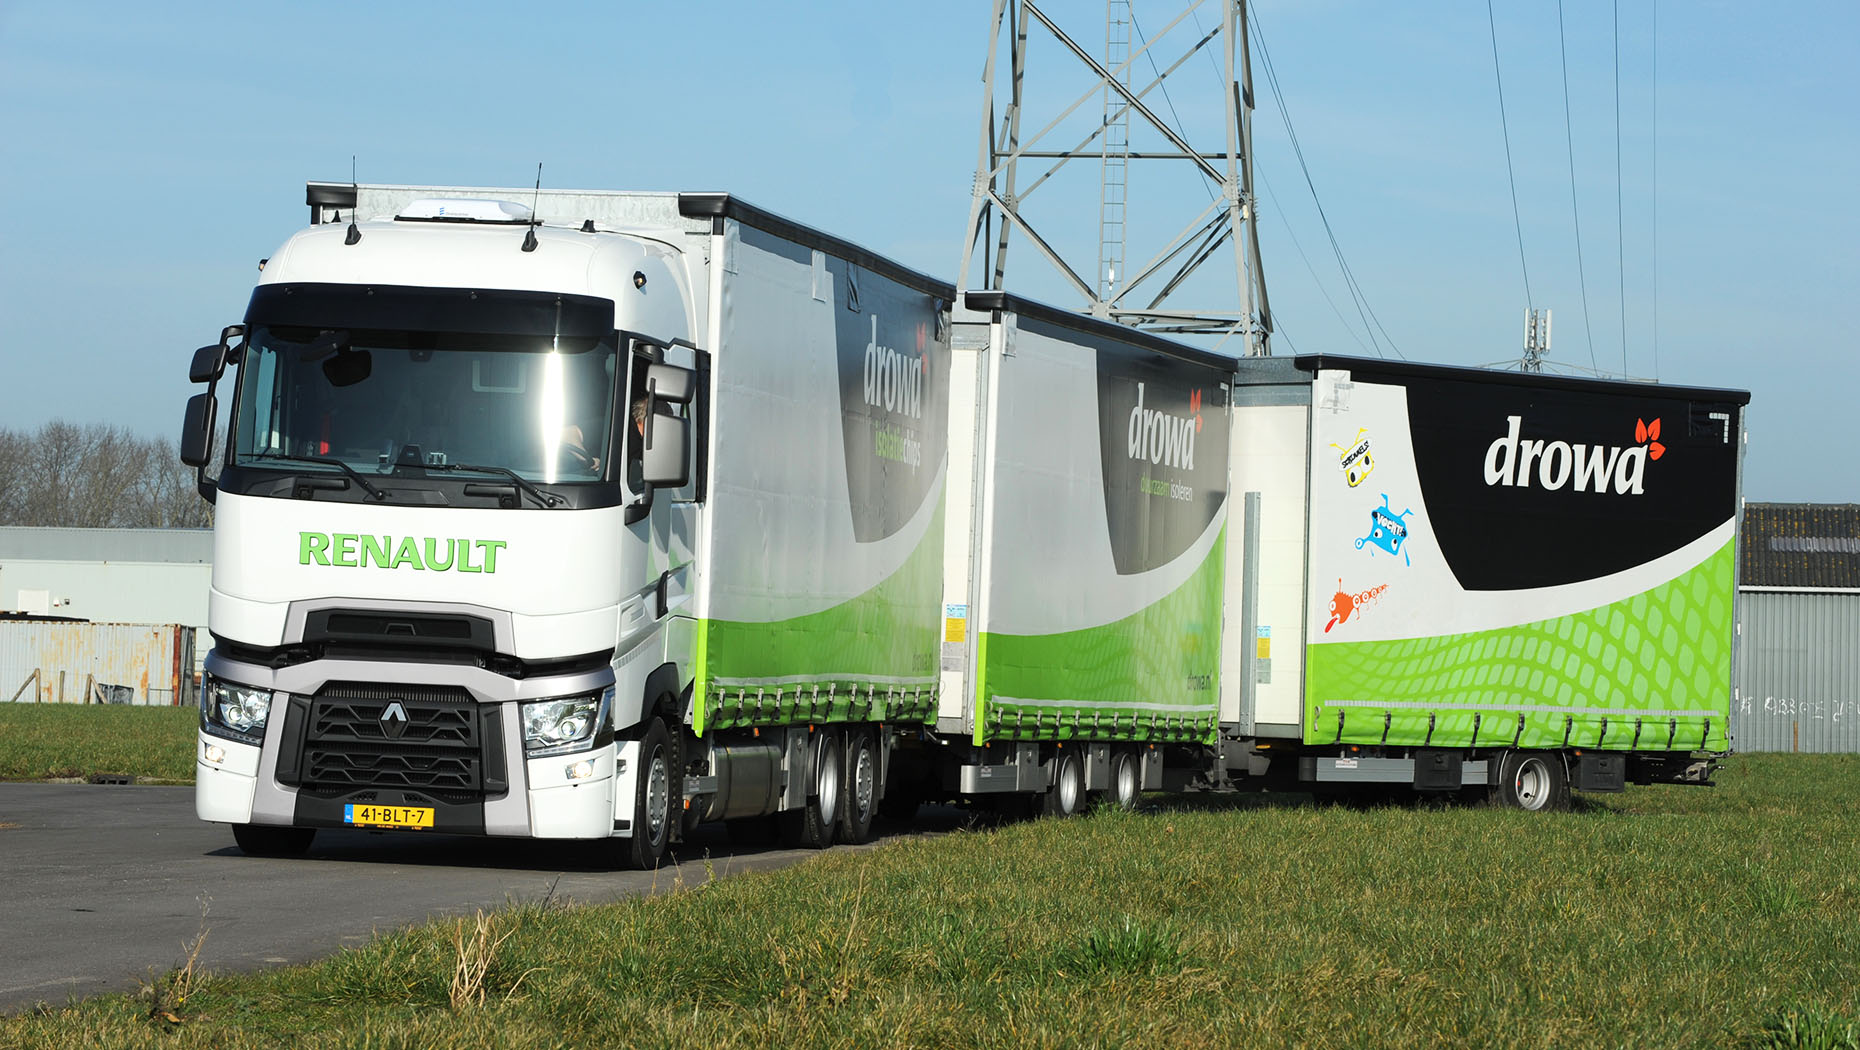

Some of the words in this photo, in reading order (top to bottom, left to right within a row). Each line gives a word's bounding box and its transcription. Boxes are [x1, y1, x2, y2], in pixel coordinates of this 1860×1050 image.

[864, 314, 921, 419] drowa
[1128, 382, 1195, 470] drowa
[1484, 415, 1648, 495] drowa
[1171, 479, 1192, 502] isoleren
[299, 531, 507, 574] RENAULT
[361, 807, 425, 824] 41-BLT-7
